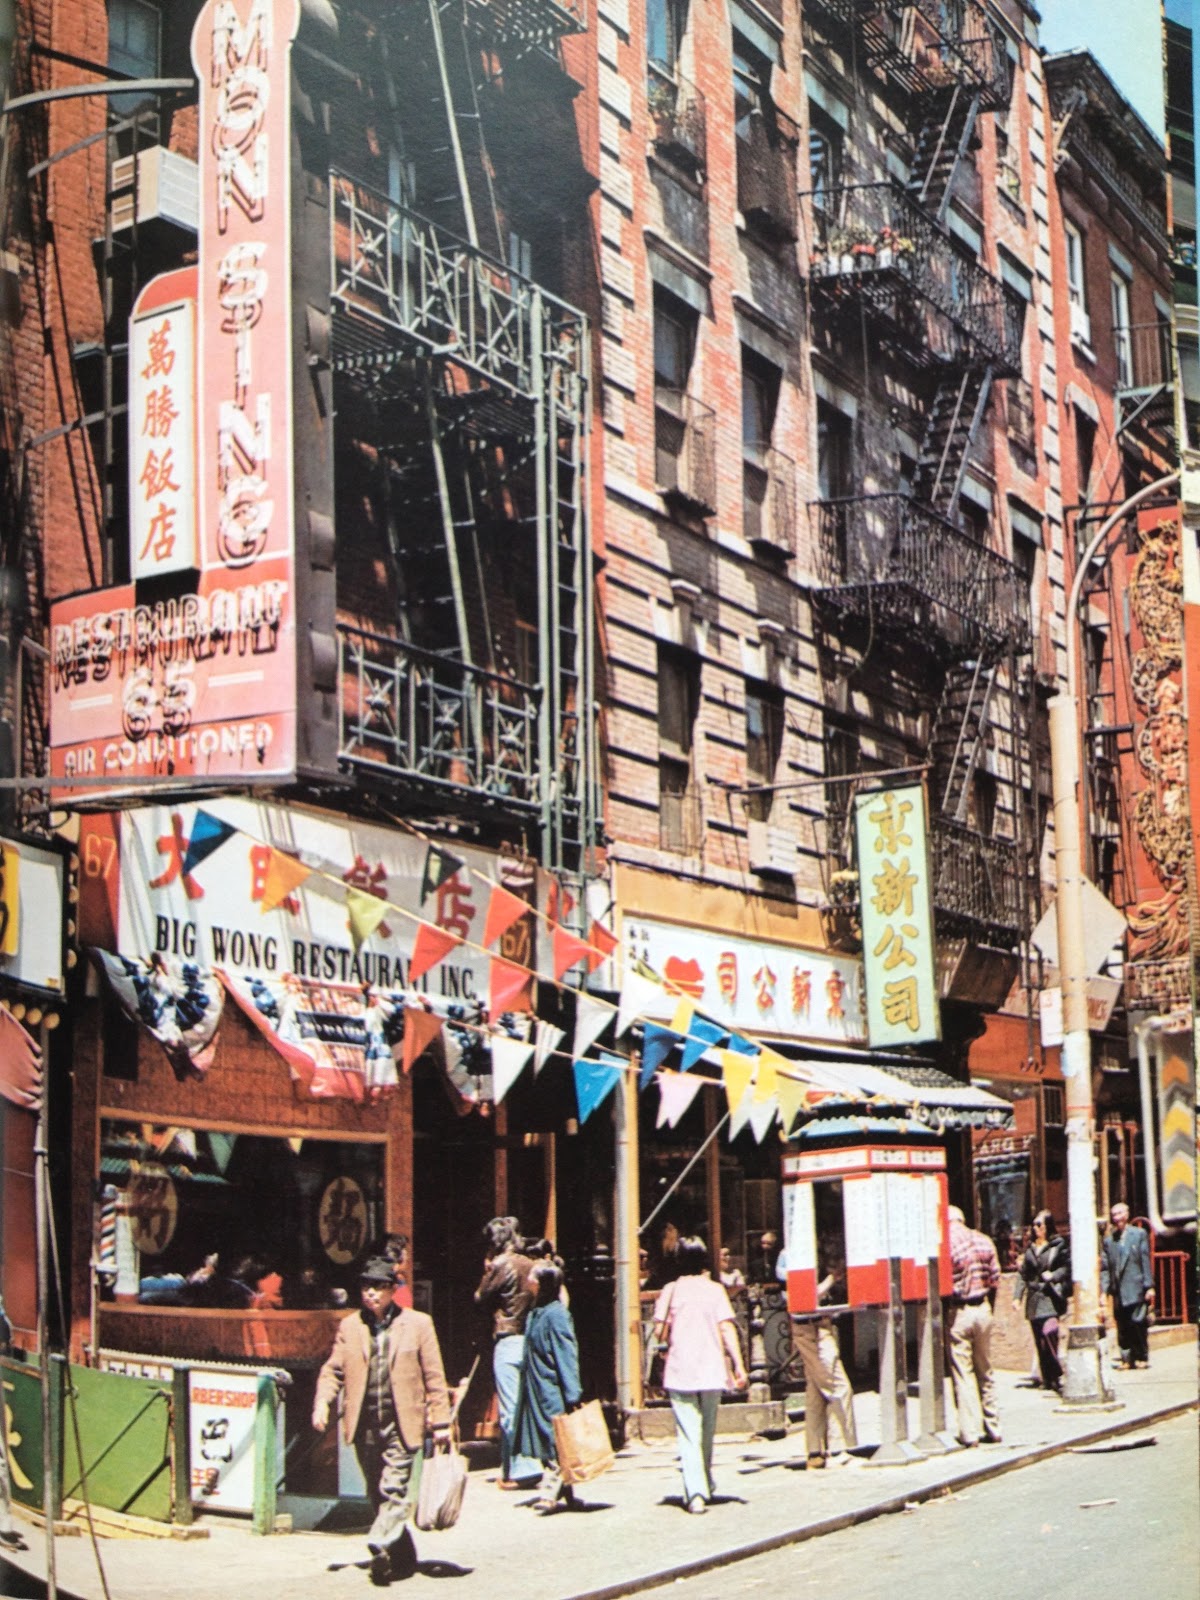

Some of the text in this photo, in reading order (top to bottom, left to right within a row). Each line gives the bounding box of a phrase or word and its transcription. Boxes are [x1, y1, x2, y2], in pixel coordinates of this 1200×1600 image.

[211, 1, 274, 569] MON SING
[140, 318, 181, 562] 萬勝飯店
[53, 579, 288, 692] RESTAURANT
[121, 660, 198, 743] 65
[64, 722, 274, 776] AIR CONDITIONED
[85, 833, 117, 878] 67
[156, 914, 198, 958] BIG
[211, 925, 277, 971] WONG
[440, 964, 478, 1001] INC.
